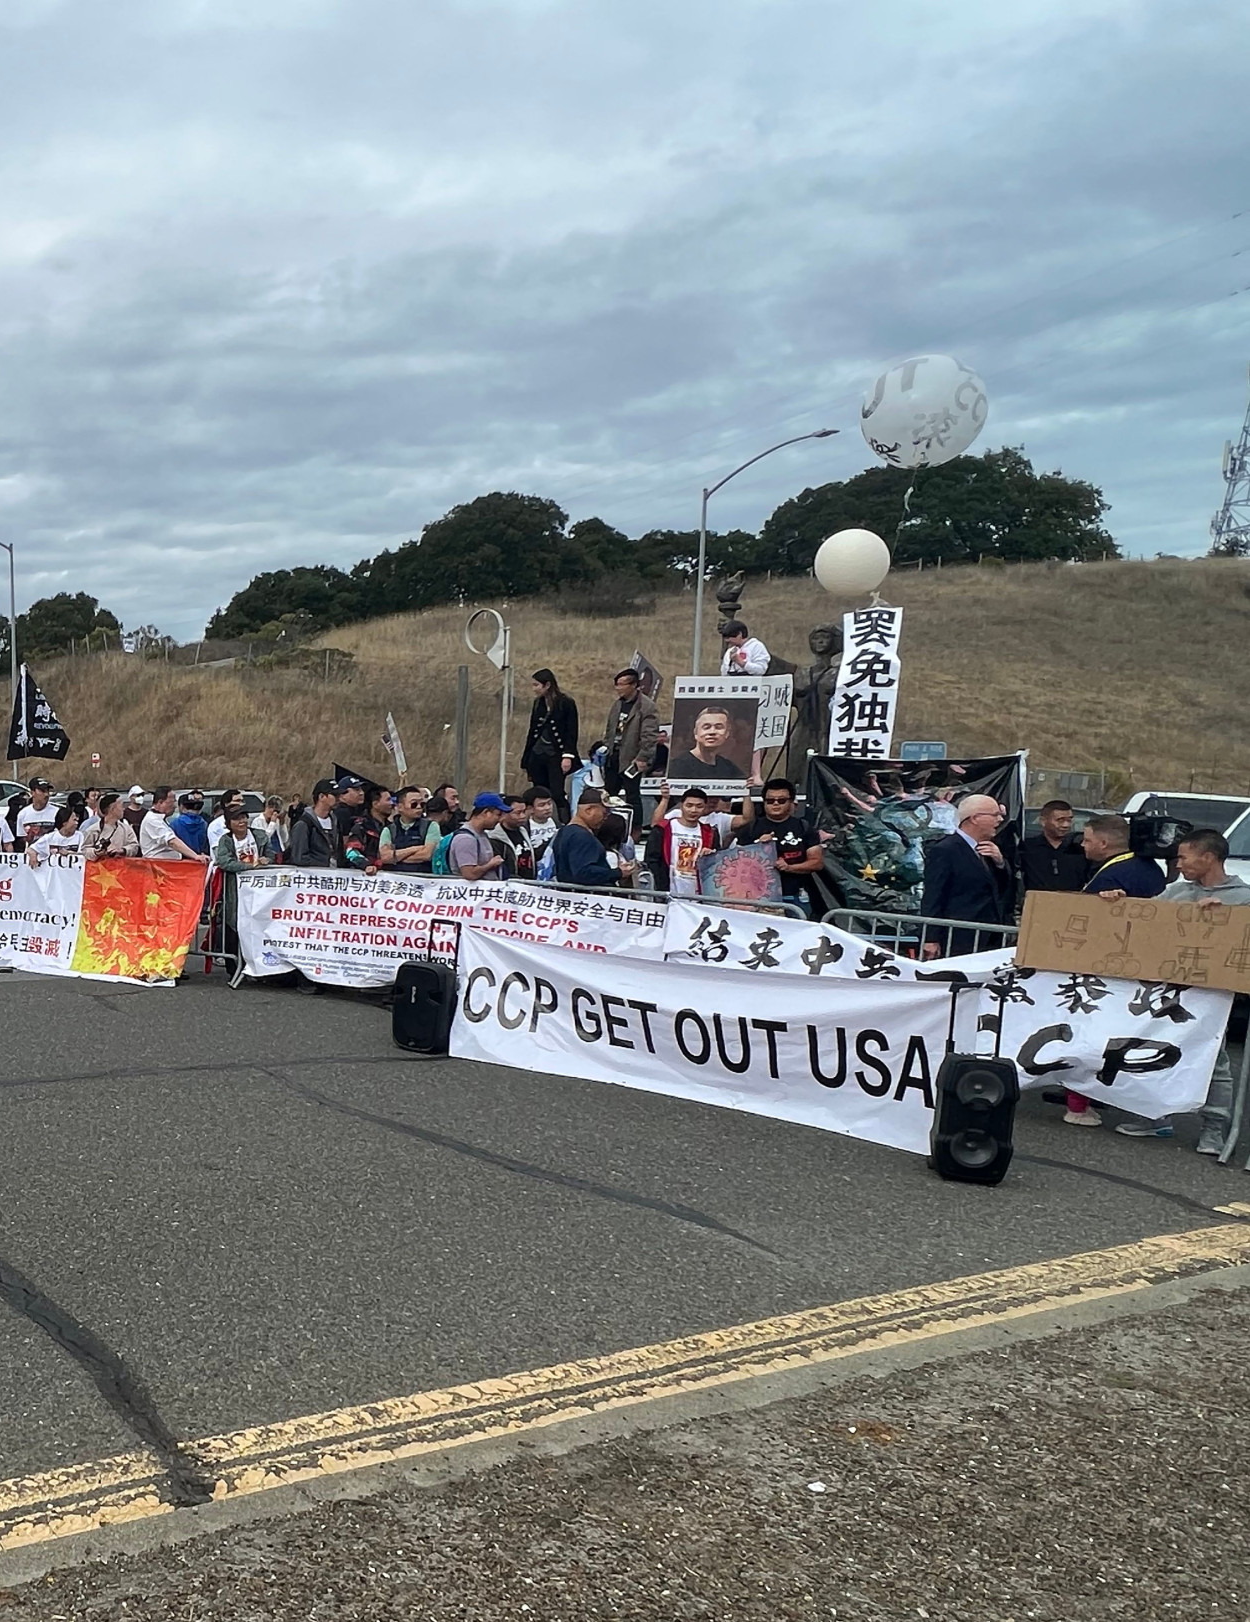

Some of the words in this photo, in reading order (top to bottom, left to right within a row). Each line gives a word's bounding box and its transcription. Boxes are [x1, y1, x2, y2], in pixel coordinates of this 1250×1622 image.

[271, 909, 335, 924] BRUTAL
[340, 913, 446, 936] REPRESSION,
[296, 893, 379, 908] STRONGLY
[384, 899, 474, 918] CONDEMN
[481, 907, 517, 923] THE
[522, 913, 579, 934] CCP'S
[289, 926, 397, 946] INFILTRATION
[304, 942, 329, 953] THAT
[333, 944, 349, 954] THE
[351, 947, 369, 957] CCP
[462, 966, 559, 1033] CCP
[570, 987, 659, 1054] GET
[673, 1007, 789, 1079] OUT
[805, 1023, 935, 1110] USA
